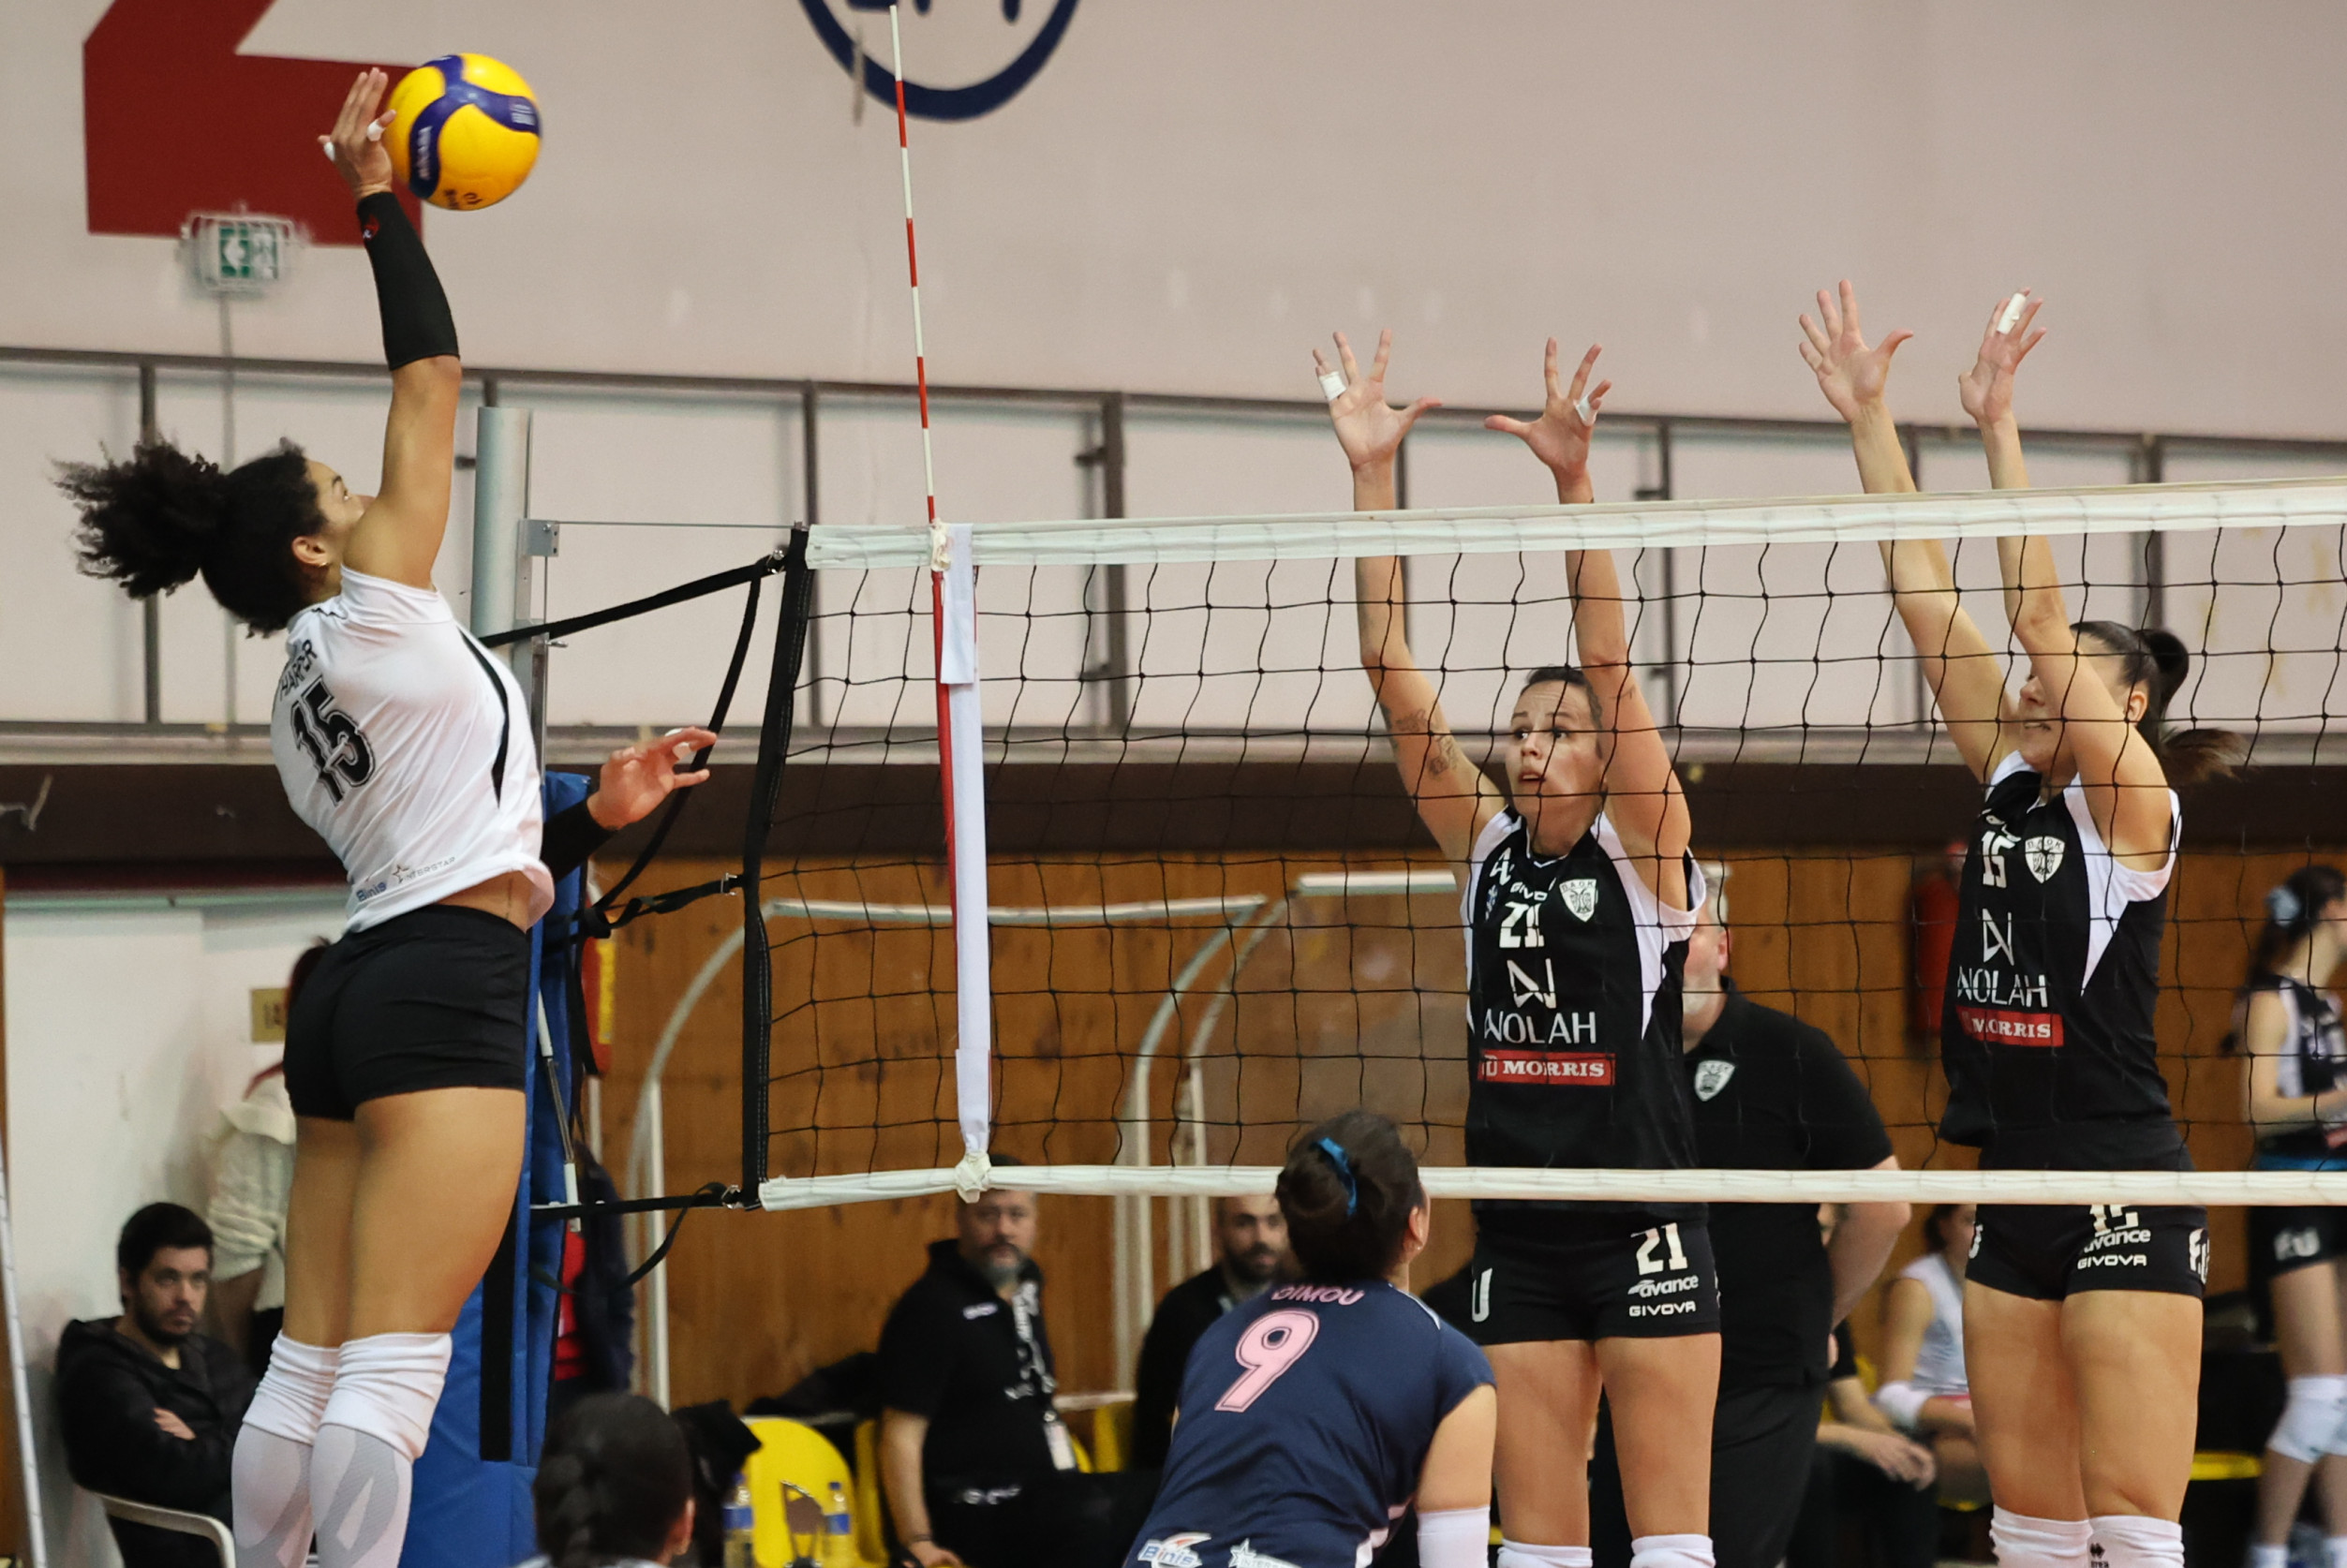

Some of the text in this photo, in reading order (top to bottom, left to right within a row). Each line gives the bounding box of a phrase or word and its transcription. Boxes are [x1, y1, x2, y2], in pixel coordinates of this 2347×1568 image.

[290, 674, 376, 807] 15
[1499, 901, 1544, 949] 21
[1956, 966, 2049, 1008] NOLAH
[1483, 1008, 1597, 1045] NOLAH
[1972, 1017, 2052, 1039] MORRIS
[1502, 1059, 1606, 1078] MORRIS
[1630, 1222, 1688, 1276] 21
[2076, 1253, 2147, 1270] GIVOVA
[1270, 1284, 1365, 1306] DIMOU
[1628, 1300, 1697, 1317] GIVOVA
[1214, 1308, 1320, 1413] 9
[1140, 1545, 1195, 1567] Binis
